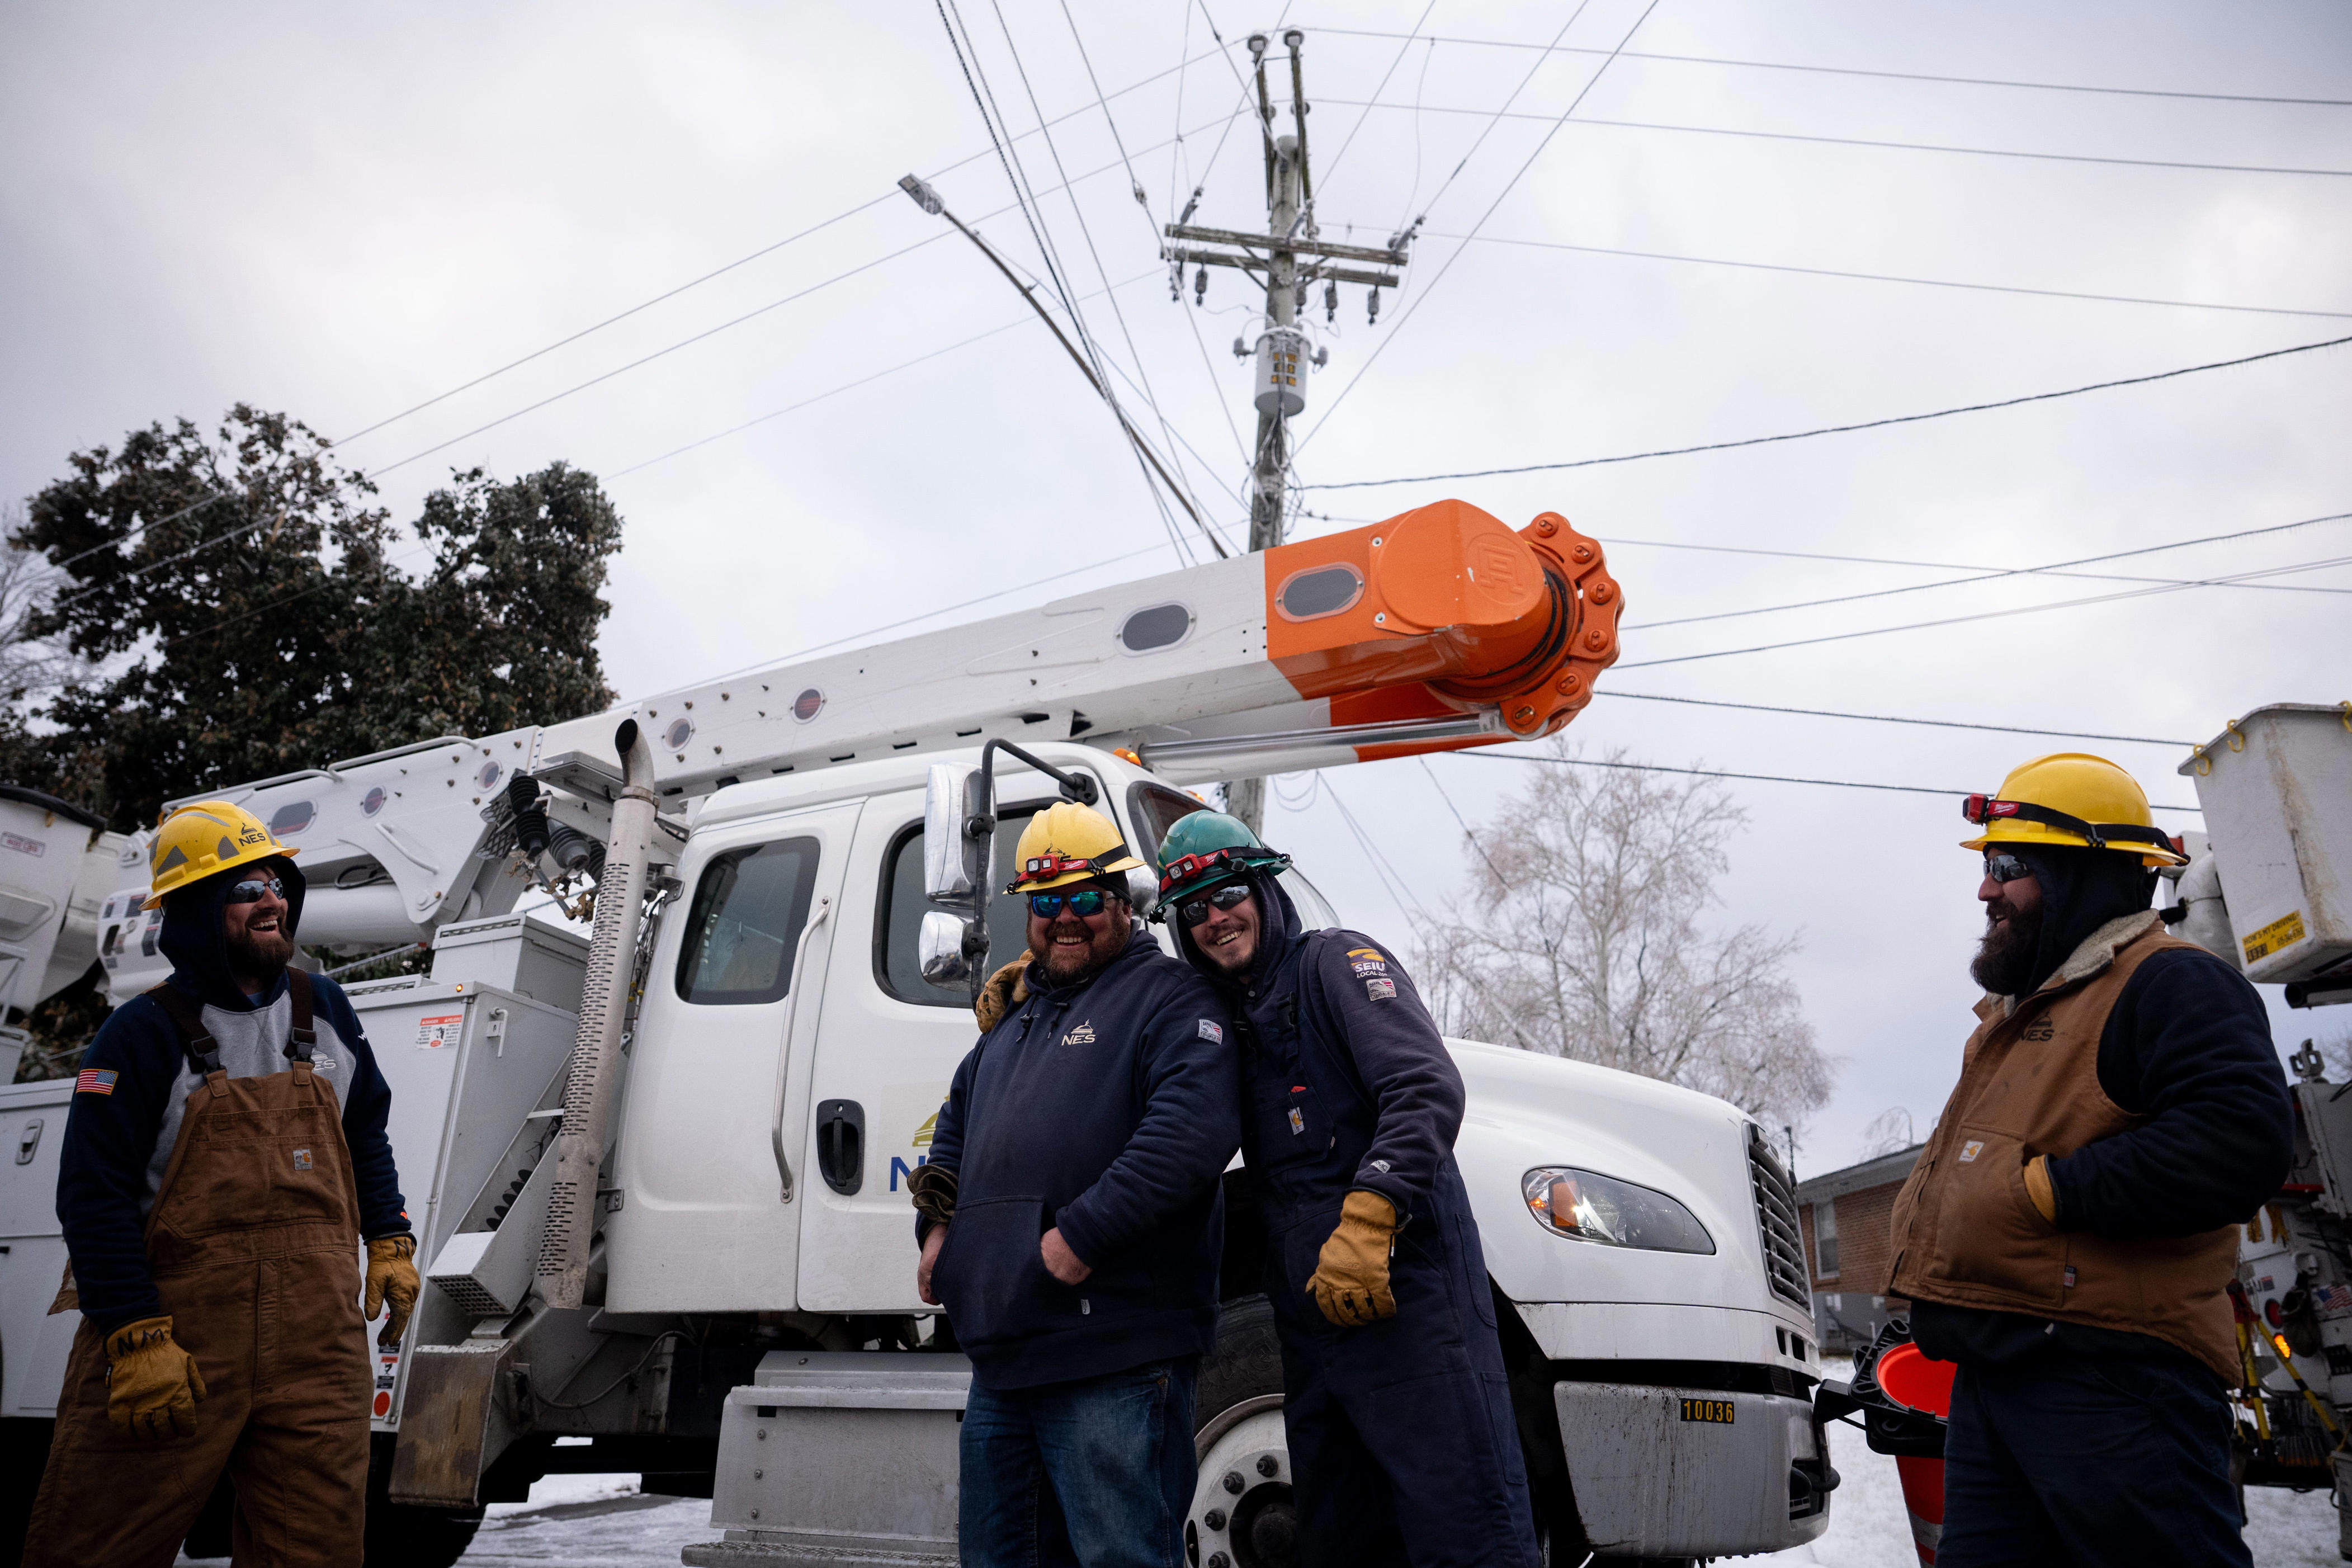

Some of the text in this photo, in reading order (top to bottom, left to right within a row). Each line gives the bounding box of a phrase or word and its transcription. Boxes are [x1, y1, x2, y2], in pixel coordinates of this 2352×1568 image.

[238, 833, 266, 847] NES
[1355, 962, 1385, 972] SEIU
[1061, 1034, 1096, 1046] NES
[314, 1059, 336, 1071] ES
[117, 1328, 164, 1356] NM
[1684, 1400, 1732, 1422] 10036
